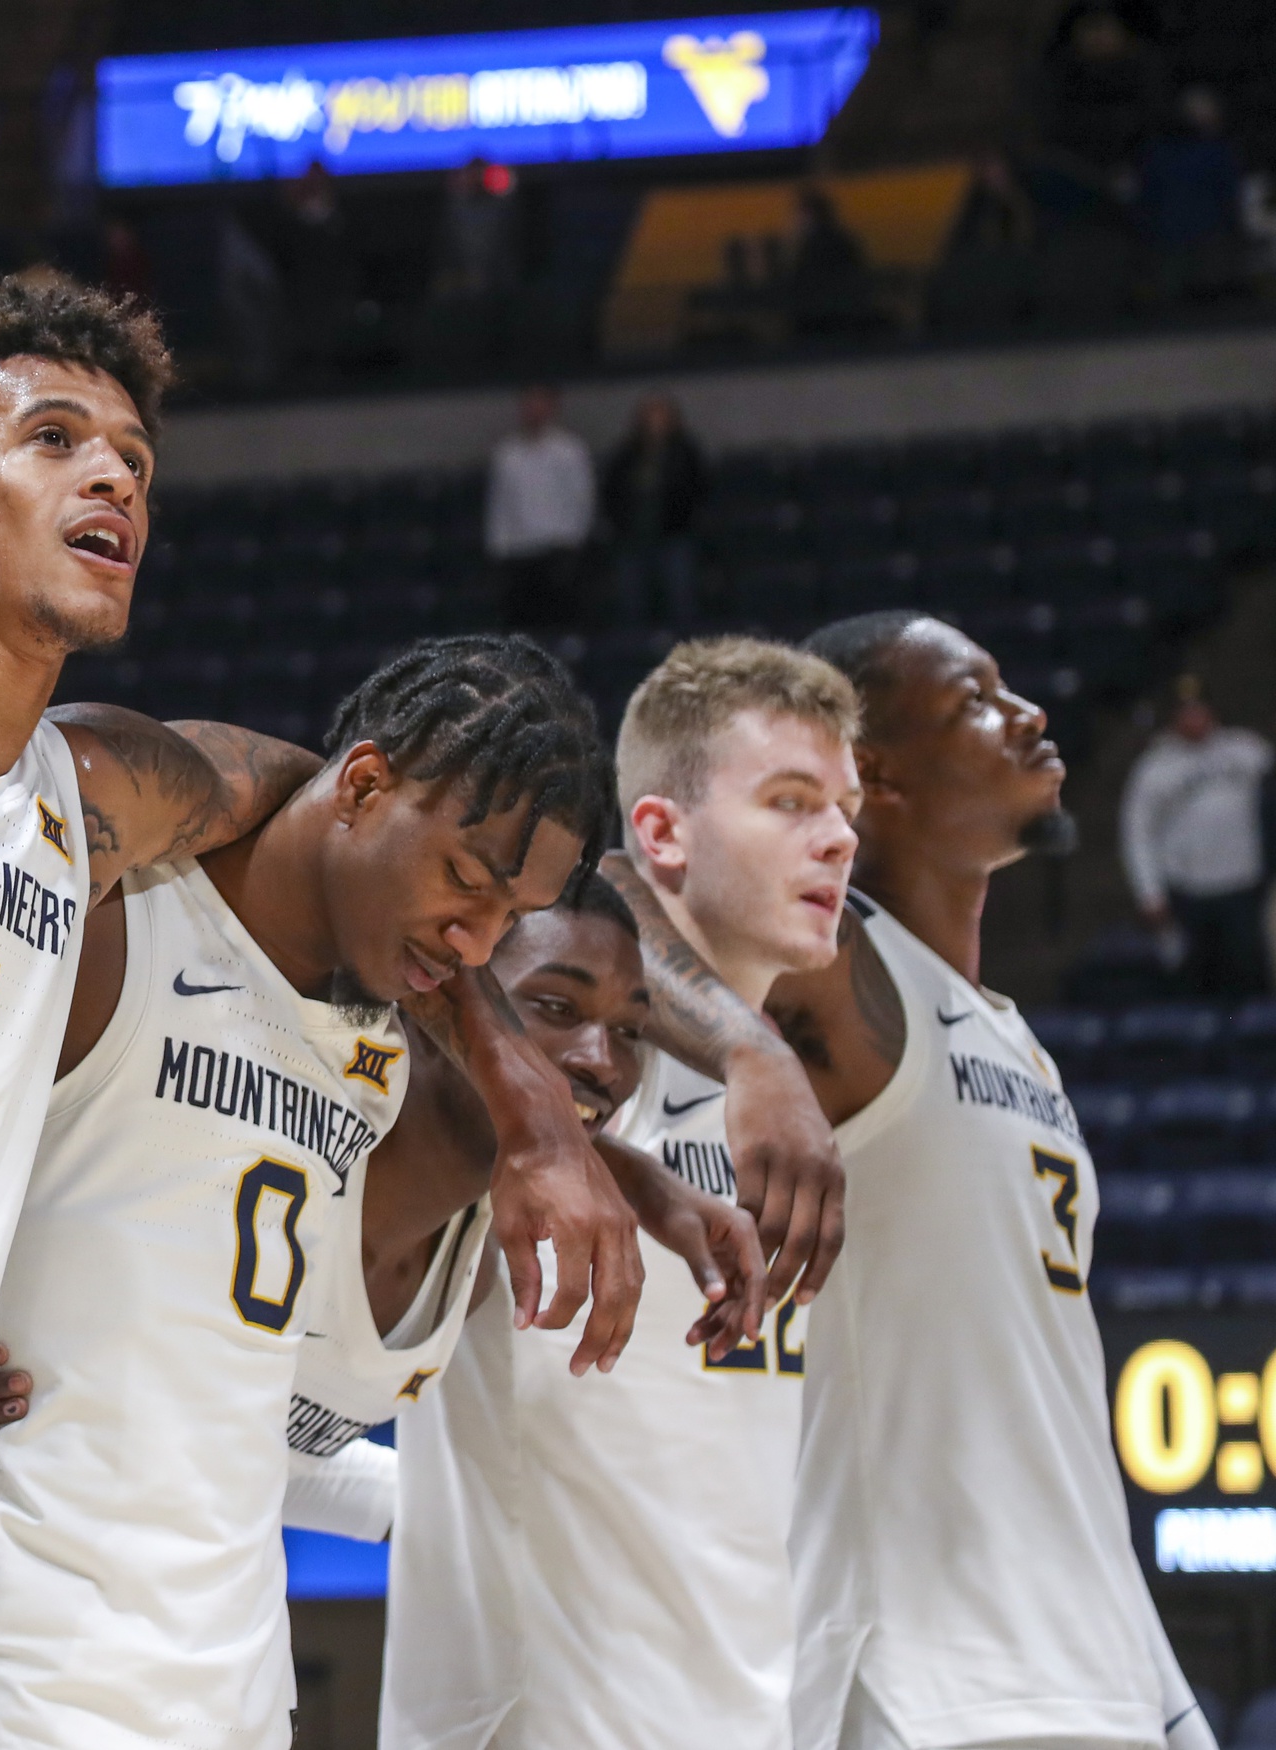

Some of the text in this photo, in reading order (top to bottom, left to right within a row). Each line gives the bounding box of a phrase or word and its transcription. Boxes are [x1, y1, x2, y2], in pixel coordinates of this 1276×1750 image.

[156, 1037, 377, 1185] MOUNTAINEERS
[229, 1156, 307, 1335] 0
[1031, 1143, 1085, 1296] 3
[1115, 1339, 1276, 1495] 0:
